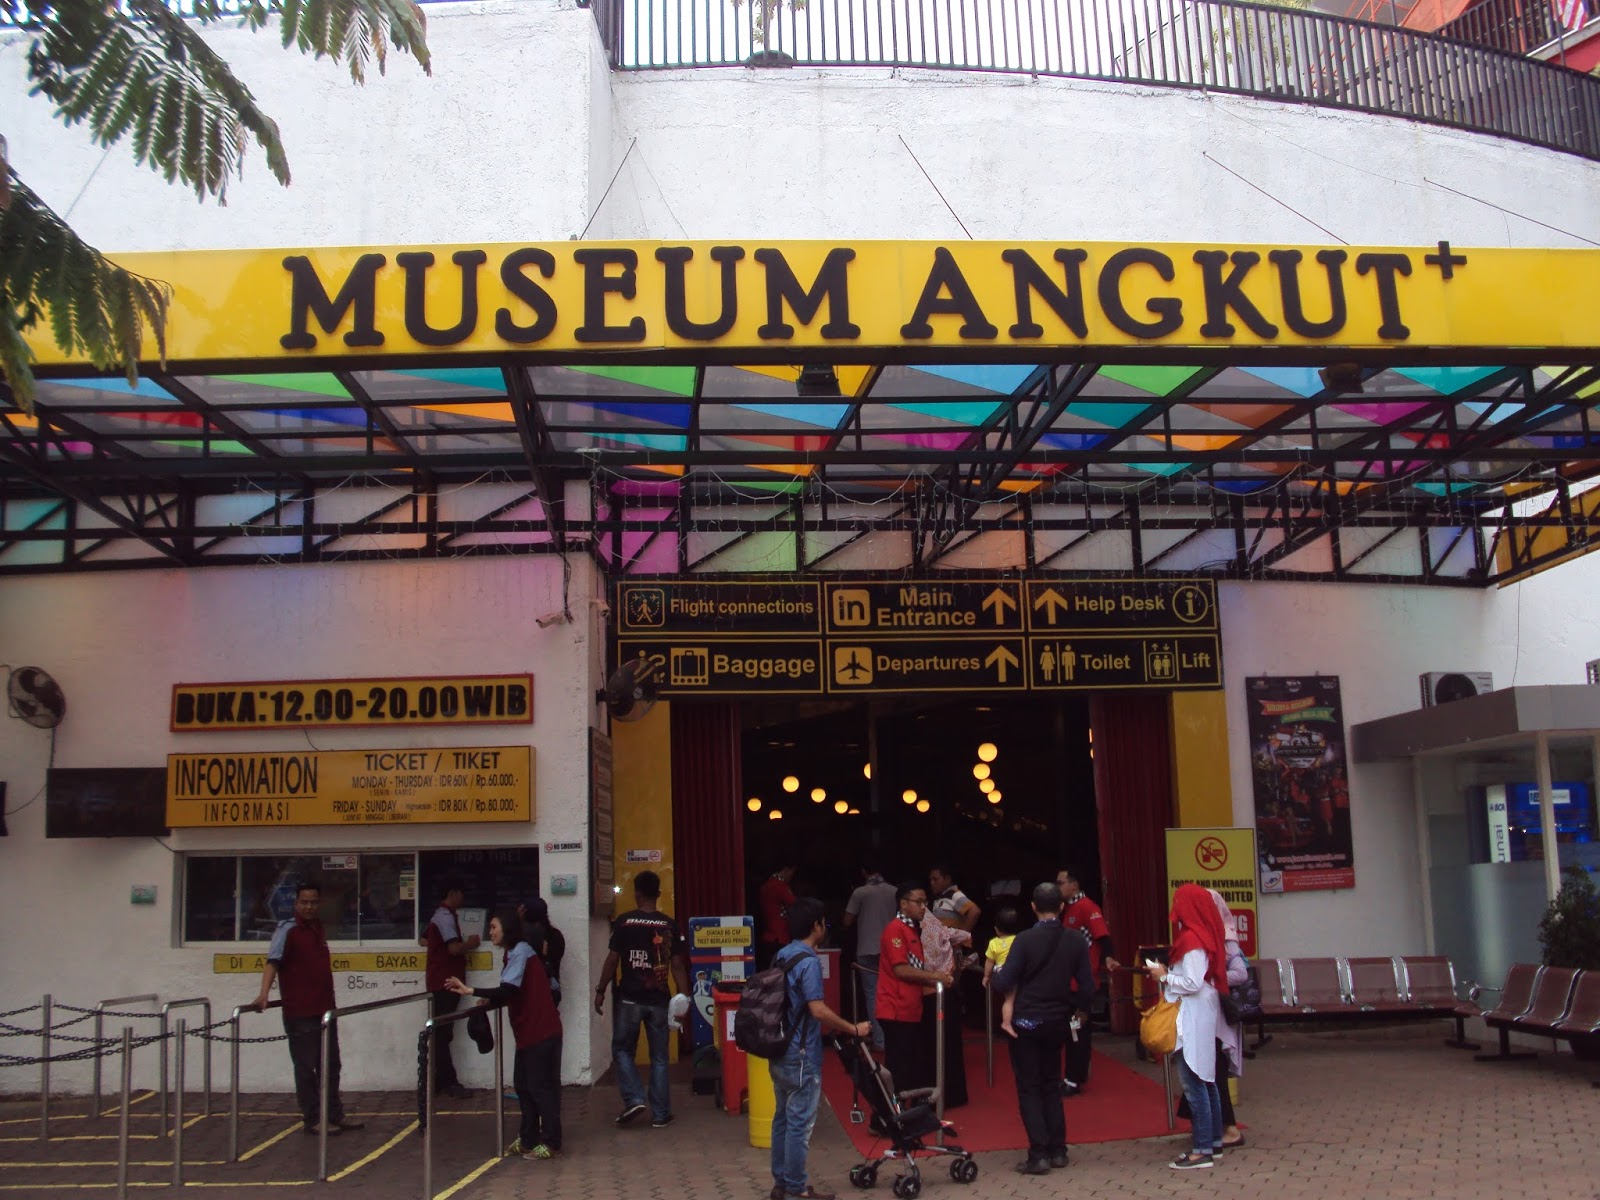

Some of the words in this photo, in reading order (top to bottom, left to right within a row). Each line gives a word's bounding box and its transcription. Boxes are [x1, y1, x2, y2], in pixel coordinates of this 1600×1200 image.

[279, 247, 861, 349] MUSEUM
[899, 588, 953, 607] Main
[1074, 596, 1115, 614] Help
[1120, 595, 1166, 611] Desk
[670, 598, 715, 617] Flight
[718, 599, 814, 614] connections
[876, 608, 976, 626] Entrance
[713, 654, 816, 679] Baggage
[876, 655, 981, 675] Departures
[1081, 654, 1131, 671] Toilet
[1181, 653, 1211, 669] Lift
[462, 684, 527, 717] WIB
[364, 753, 428, 771] TICKET
[452, 751, 501, 770] TIKET
[175, 756, 318, 796] INFORMATION
[352, 775, 388, 789] MONDAY
[394, 775, 433, 788] THURSDAY
[204, 802, 290, 822] INFORMASI
[332, 801, 360, 813] FRIDAY
[365, 800, 397, 812] SUNDAY
[1212, 880, 1253, 888] BEVERAGES
[230, 958, 243, 969] DI
[376, 957, 418, 968] BAYAR
